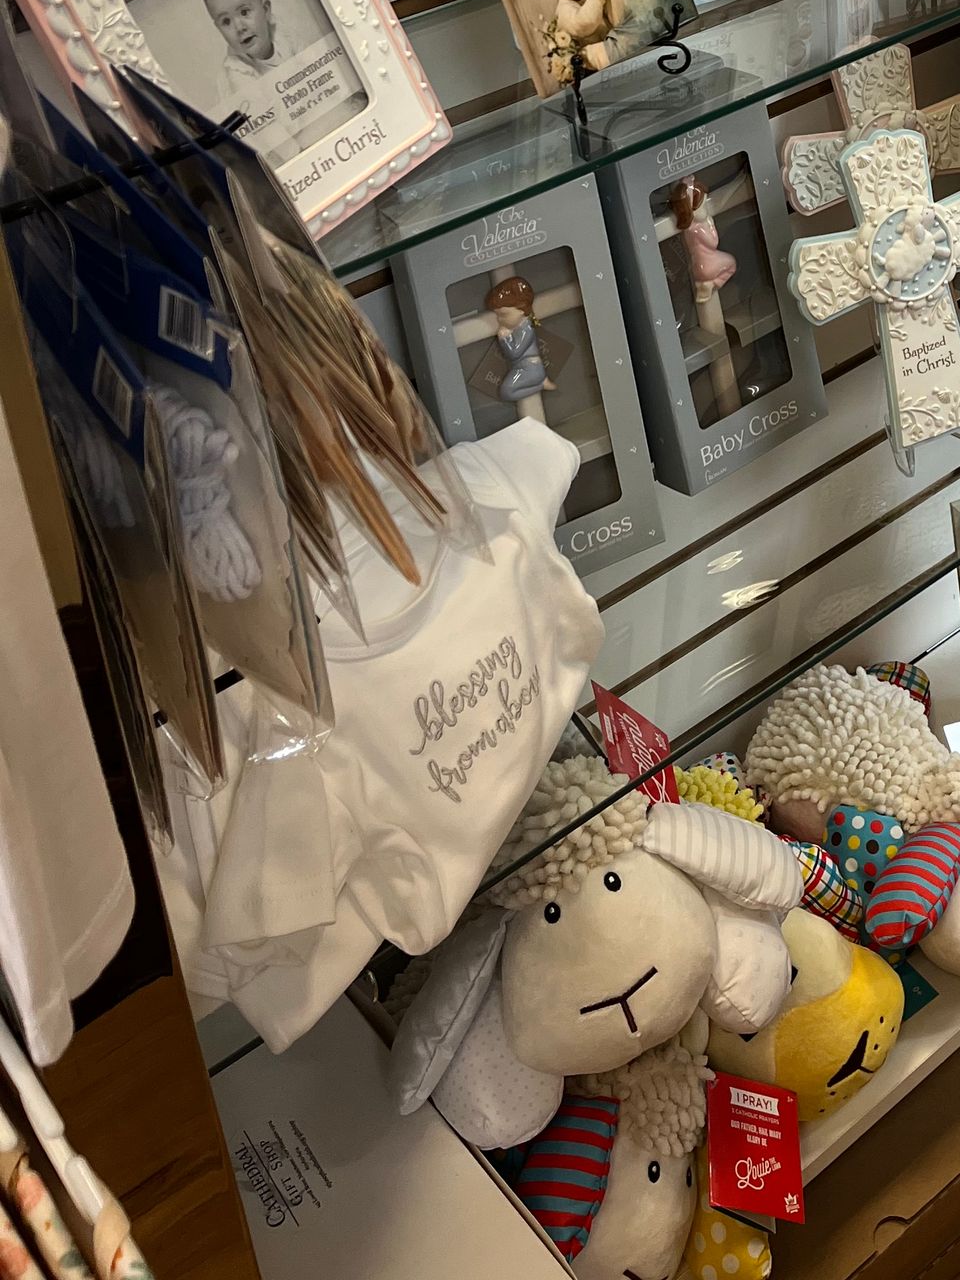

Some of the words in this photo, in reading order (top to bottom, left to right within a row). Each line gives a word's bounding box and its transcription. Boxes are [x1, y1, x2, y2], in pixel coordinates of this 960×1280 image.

[275, 46, 342, 94] Commemorative
[282, 87, 308, 109] Photo
[306, 70, 334, 92] Frame
[283, 161, 321, 201] tized
[319, 156, 336, 172] in
[335, 119, 386, 162] Christ
[498, 204, 526, 224] The
[461, 215, 538, 258] Valencia
[469, 234, 543, 264] COLLECTION
[902, 335, 947, 361] Baptized
[902, 365, 914, 377] in
[916, 351, 956, 376] Christ
[700, 428, 746, 468] Baby
[749, 400, 798, 436] Cross
[571, 515, 633, 554] Cross
[409, 636, 522, 755] blessing
[427, 728, 498, 803] from
[496, 665, 541, 735] abov
[742, 1094, 773, 1111] PRAY!
[259, 1140, 282, 1171] SHOP
[735, 1157, 771, 1190] Louie
[235, 1142, 286, 1227] CATHEDRAL
[281, 1177, 303, 1207] GIFT
